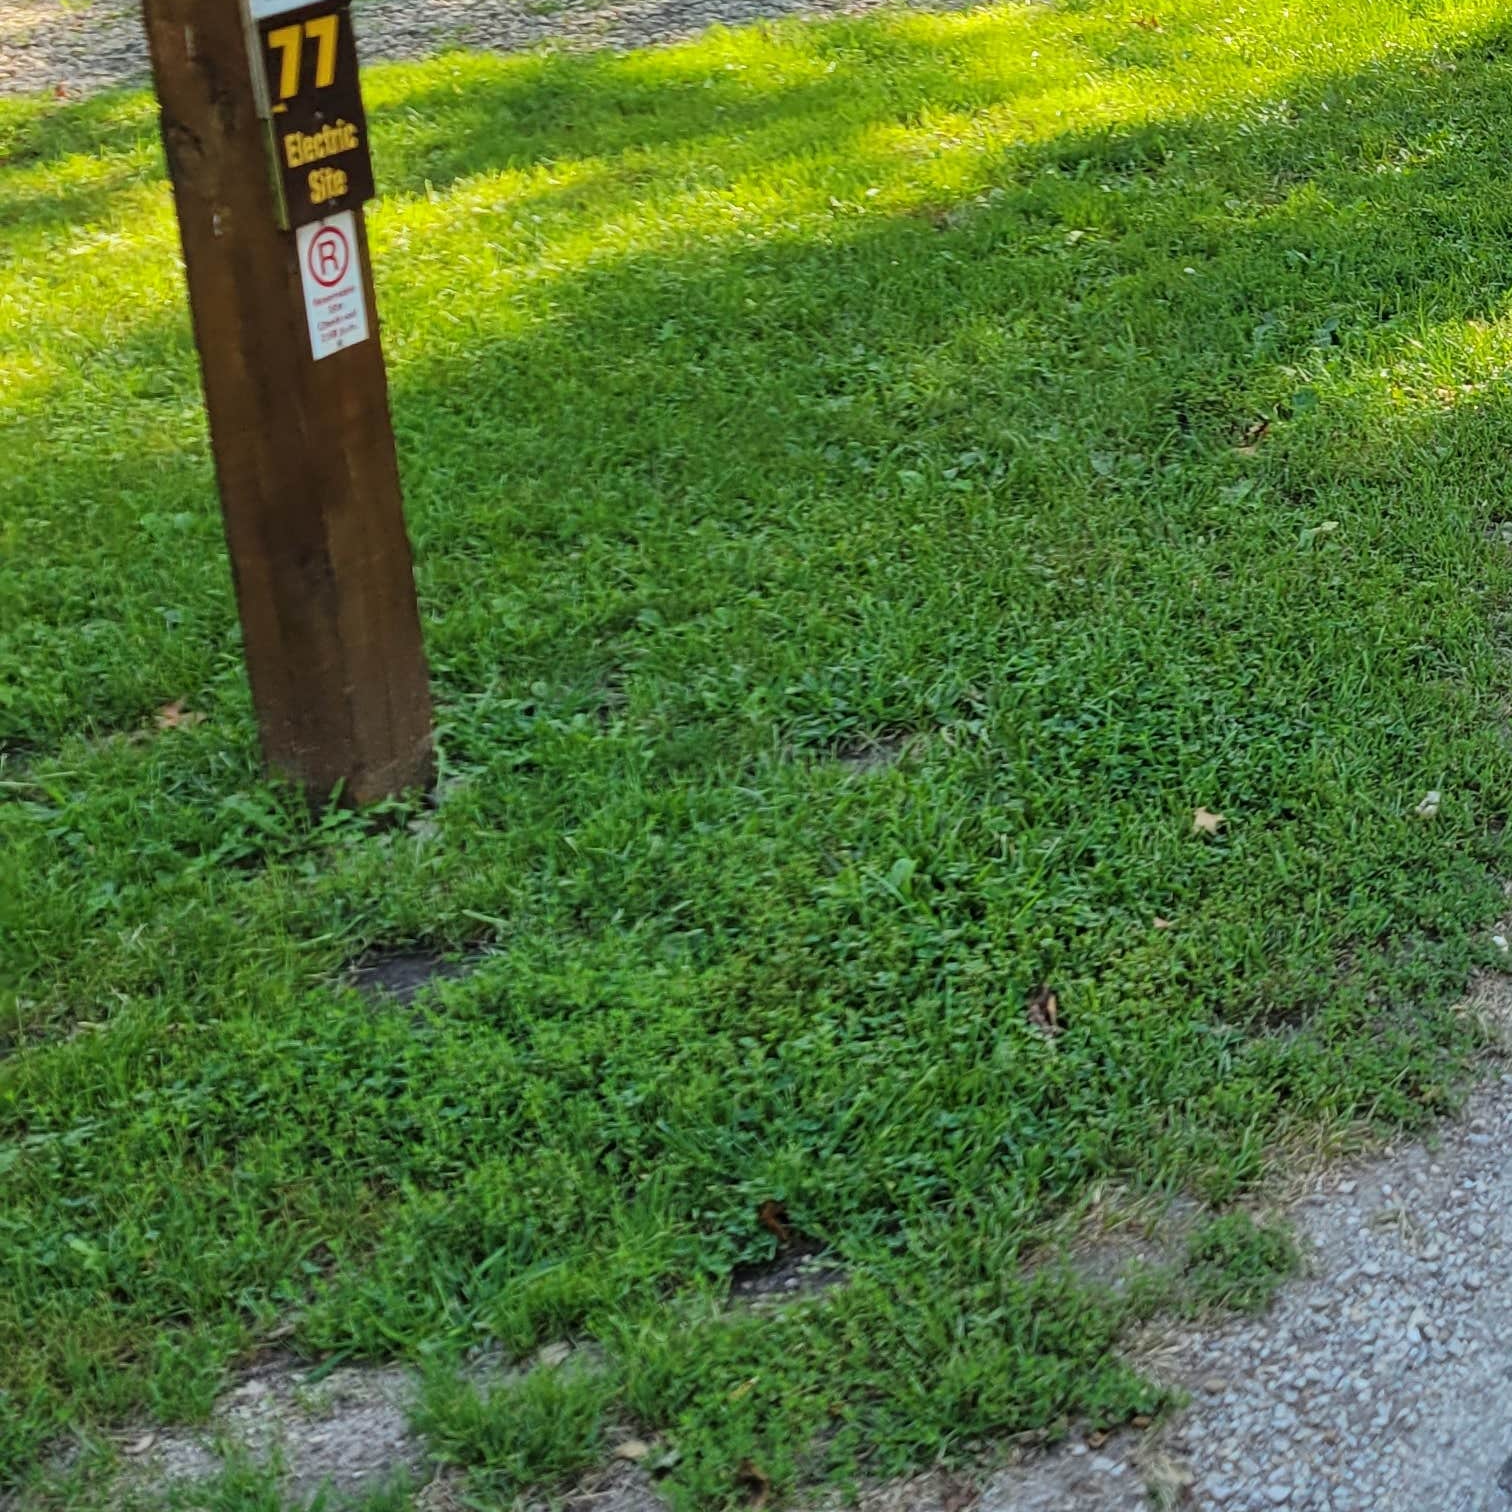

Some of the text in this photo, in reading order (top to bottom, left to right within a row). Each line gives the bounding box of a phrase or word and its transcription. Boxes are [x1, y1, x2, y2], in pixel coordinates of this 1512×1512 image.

[267, 14, 340, 100] 77
[283, 118, 359, 169] Electric
[308, 167, 348, 205] Site
[318, 239, 340, 276] R
